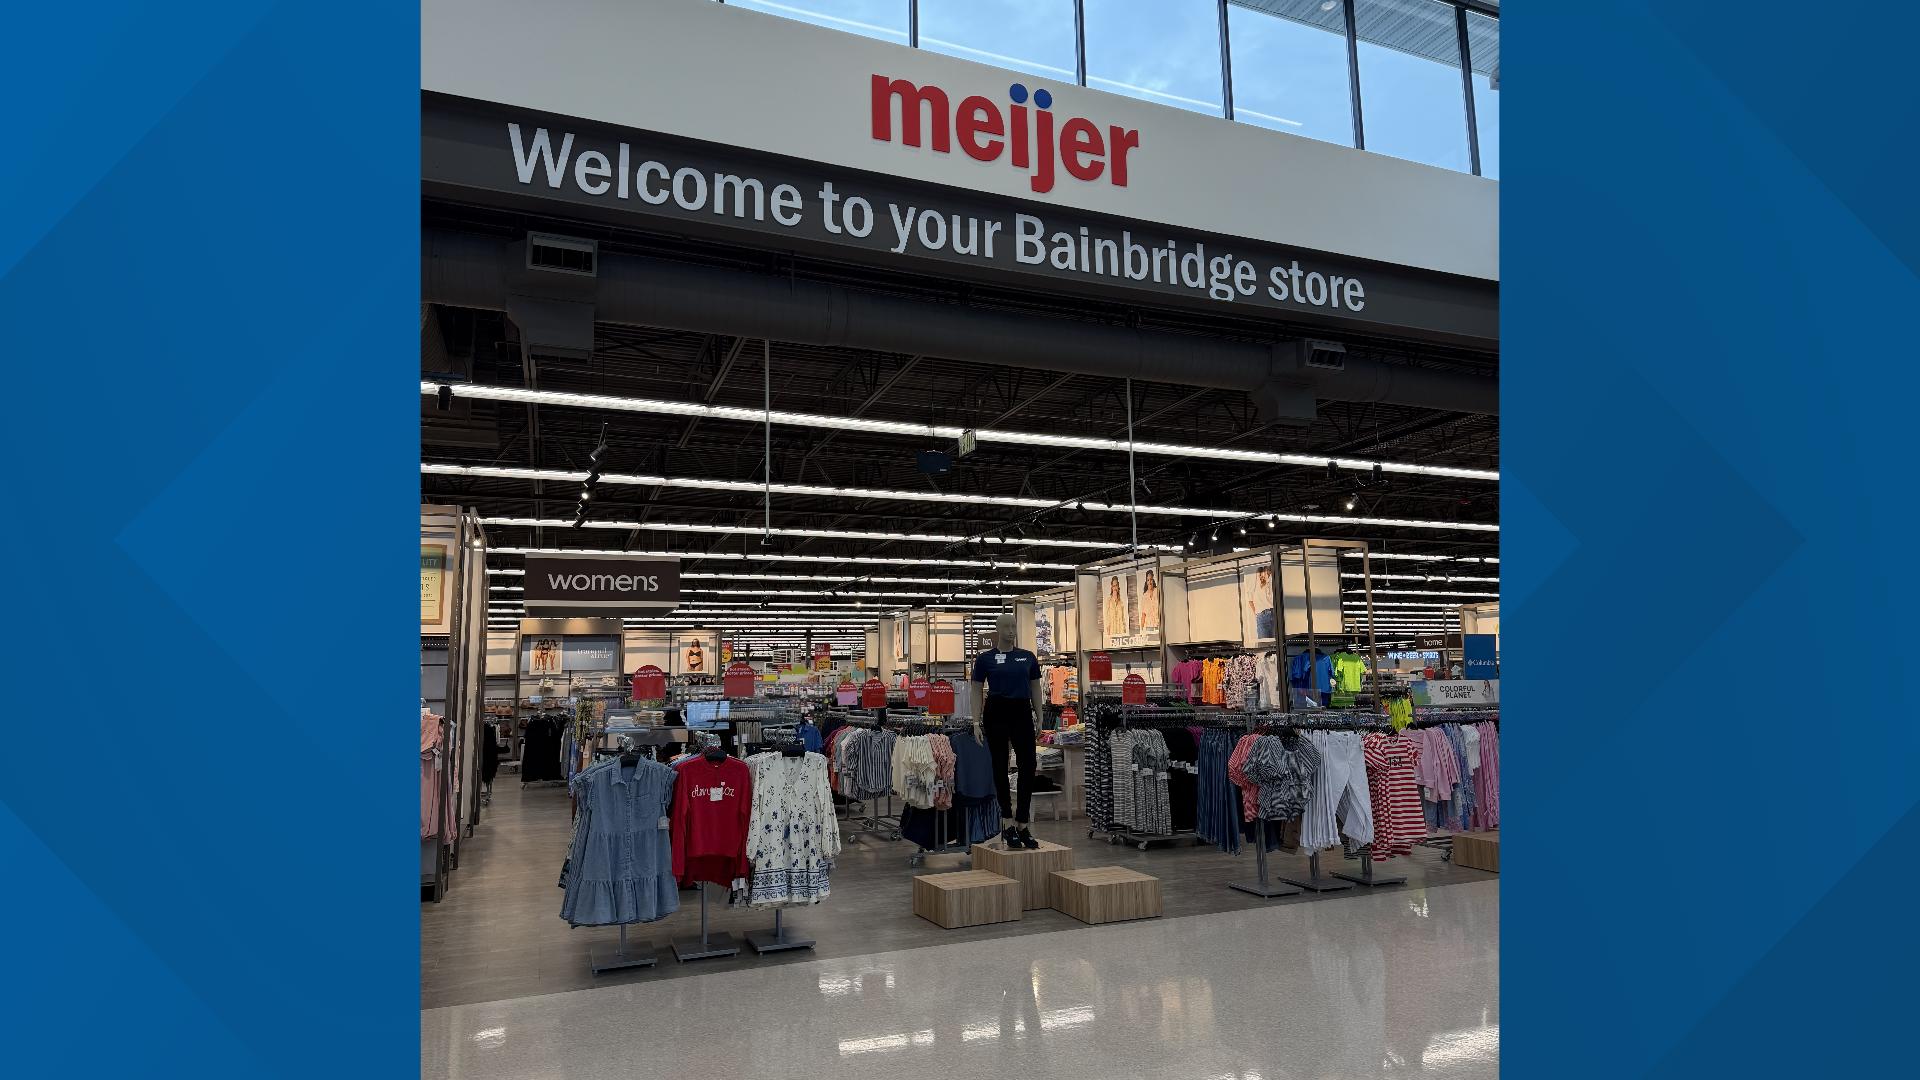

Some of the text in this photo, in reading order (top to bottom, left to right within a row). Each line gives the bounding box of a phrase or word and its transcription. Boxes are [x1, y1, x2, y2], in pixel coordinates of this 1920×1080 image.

[872, 74, 1139, 193] meijer
[507, 121, 1366, 312] Welcome to your Bainbridge store
[548, 573, 659, 592] womens
[1440, 685, 1475, 693] COLORFUL
